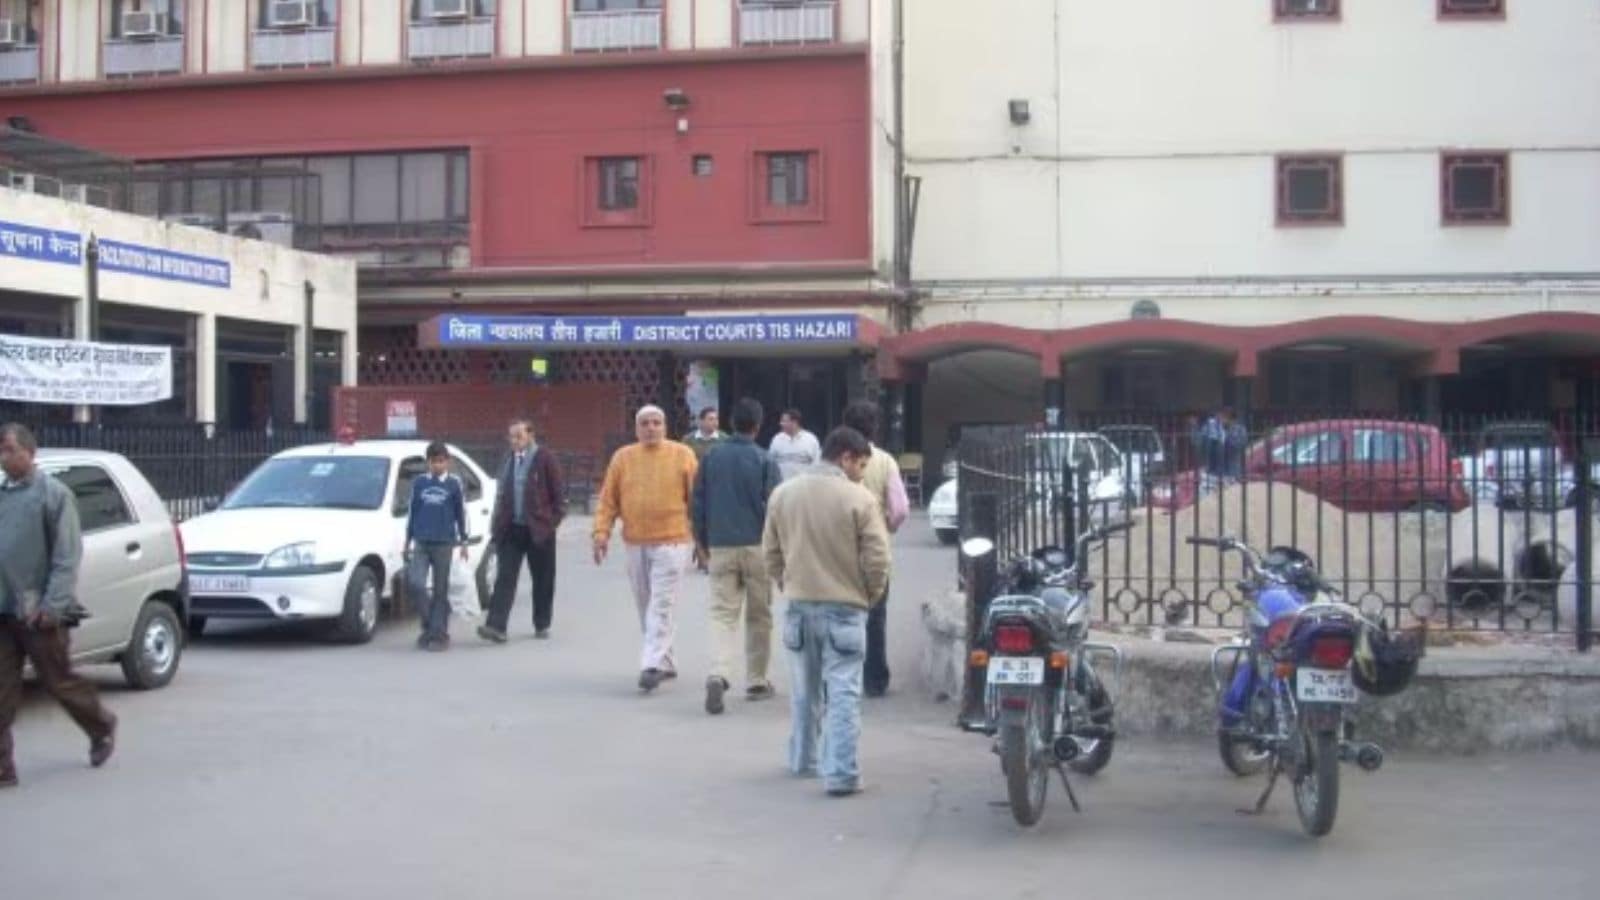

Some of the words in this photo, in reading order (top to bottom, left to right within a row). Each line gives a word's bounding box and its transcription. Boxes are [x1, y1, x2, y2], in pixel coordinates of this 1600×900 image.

[449, 317, 482, 341] जिला
[489, 323, 544, 341] न्यायालय
[552, 318, 577, 341] तीस
[584, 317, 622, 342] हजारी
[634, 325, 701, 341] DISTRICT
[705, 323, 766, 341] COURTS
[769, 322, 791, 338] TIS
[795, 320, 851, 338] HAZARI
